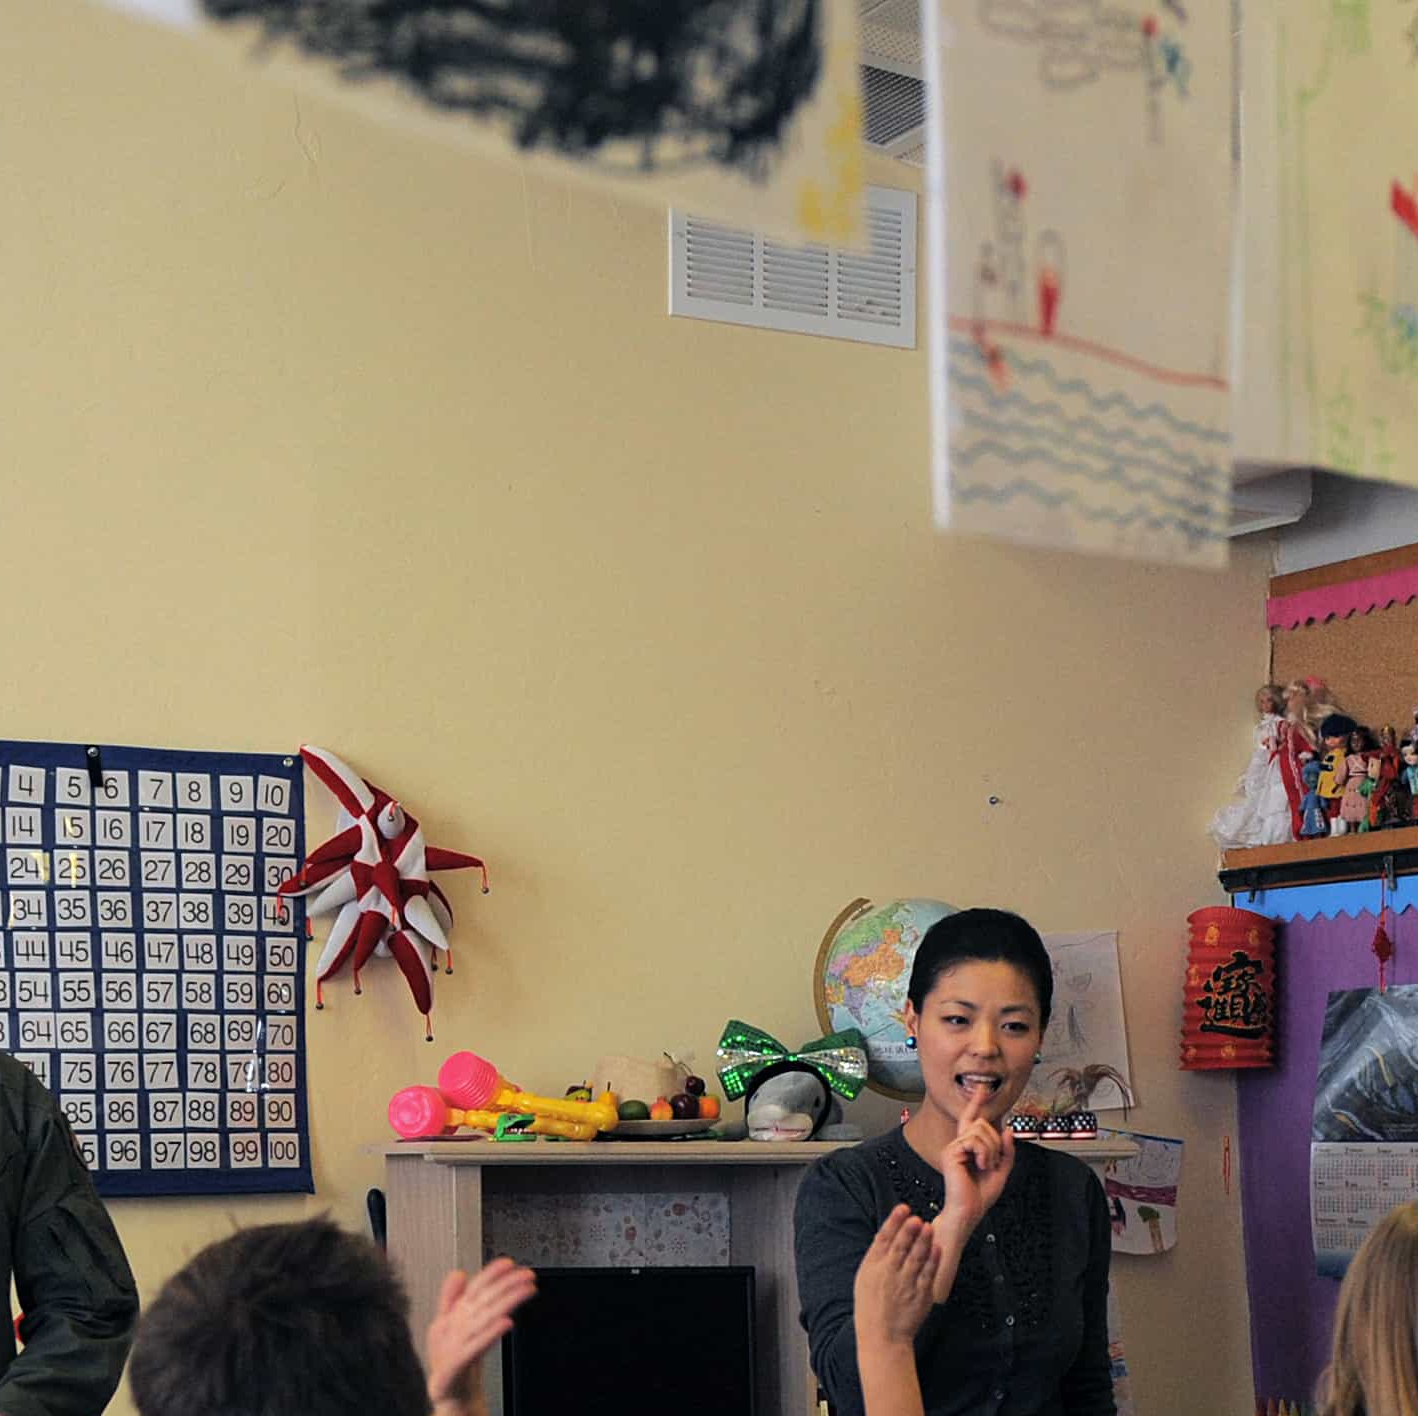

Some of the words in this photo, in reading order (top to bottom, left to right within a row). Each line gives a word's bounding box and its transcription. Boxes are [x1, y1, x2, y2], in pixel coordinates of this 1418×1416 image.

[18, 774, 34, 797] 4
[67, 775, 82, 799] 5
[102, 776, 120, 801] 6
[149, 778, 164, 800] 7
[187, 780, 202, 803] 8
[229, 781, 244, 804] 9
[264, 783, 284, 807] 10
[12, 815, 35, 838] 14
[62, 816, 84, 839] 15
[103, 817, 124, 841] 16
[145, 820, 166, 843] 17
[184, 821, 205, 844] 18
[230, 824, 250, 847] 19
[265, 824, 292, 848] 20
[9, 856, 37, 879] 24
[58, 857, 87, 880] 25
[98, 857, 126, 881] 26
[144, 859, 172, 882] 27
[184, 860, 212, 884] 28
[224, 863, 251, 886] 29
[266, 865, 294, 886] 30
[13, 898, 43, 921] 34
[57, 897, 87, 921] 35
[99, 898, 128, 922] 36
[146, 900, 173, 923] 37
[182, 900, 210, 924] 38
[227, 902, 254, 925] 39
[263, 903, 291, 927] 40
[15, 939, 47, 962] 44
[59, 940, 89, 963] 45
[104, 940, 134, 964] 46
[147, 941, 175, 964] 47
[185, 942, 214, 965] 48
[226, 943, 254, 967] 49
[269, 944, 295, 968] 50
[18, 980, 49, 1003] 54
[62, 979, 91, 1003] 55
[105, 980, 133, 1003] 56
[146, 980, 174, 1004] 57
[184, 981, 213, 1004] 58
[225, 981, 254, 1004] 59
[266, 982, 293, 1005] 60
[21, 1020, 53, 1043] 64
[60, 1020, 89, 1044] 65
[107, 1020, 136, 1044] 66
[145, 1021, 174, 1044] 67
[189, 1021, 217, 1045] 68
[227, 1019, 254, 1043] 69
[268, 1023, 294, 1047] 70
[63, 1061, 93, 1084] 75
[106, 1060, 135, 1084] 76
[145, 1060, 175, 1084] 77
[190, 1061, 218, 1084] 78
[228, 1060, 255, 1085] 79
[267, 1061, 293, 1084] 80
[65, 1101, 93, 1125] 85
[107, 1100, 136, 1124] 86
[152, 1100, 180, 1123] 87
[187, 1099, 216, 1124] 88
[229, 1100, 256, 1123] 89
[267, 1100, 293, 1123] 90
[109, 1139, 138, 1163] 96
[153, 1140, 182, 1164] 97
[189, 1140, 217, 1163] 98
[232, 1139, 259, 1163] 99
[269, 1140, 297, 1161] 100
